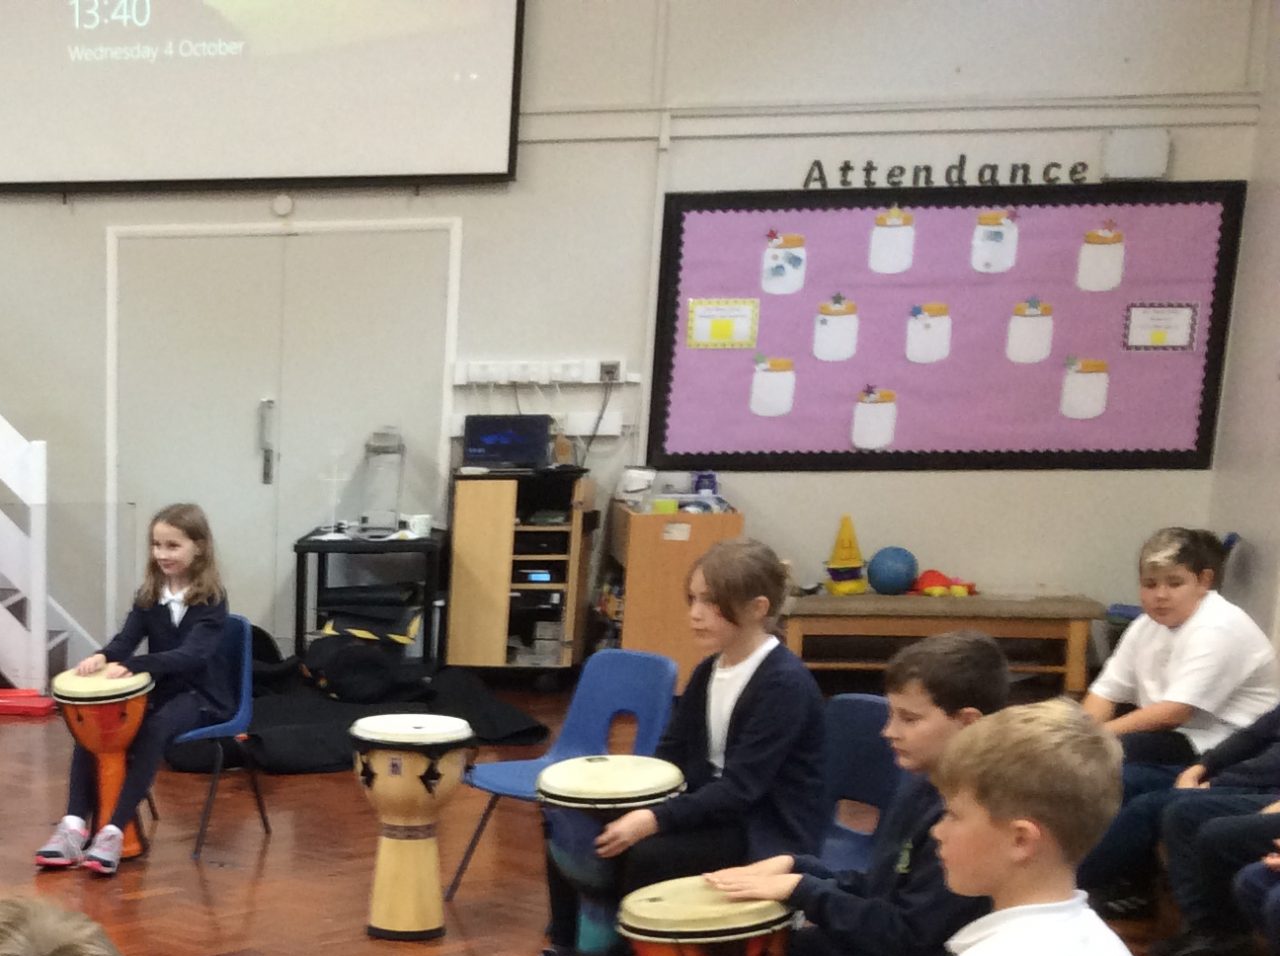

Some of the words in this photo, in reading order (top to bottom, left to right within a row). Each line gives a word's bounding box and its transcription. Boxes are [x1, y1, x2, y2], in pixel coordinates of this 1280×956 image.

[70, 0, 151, 29] 13:40
[68, 44, 159, 63] Wednesday
[164, 41, 173, 57] 4
[178, 38, 245, 58] October
[803, 153, 1089, 189] Attendance
